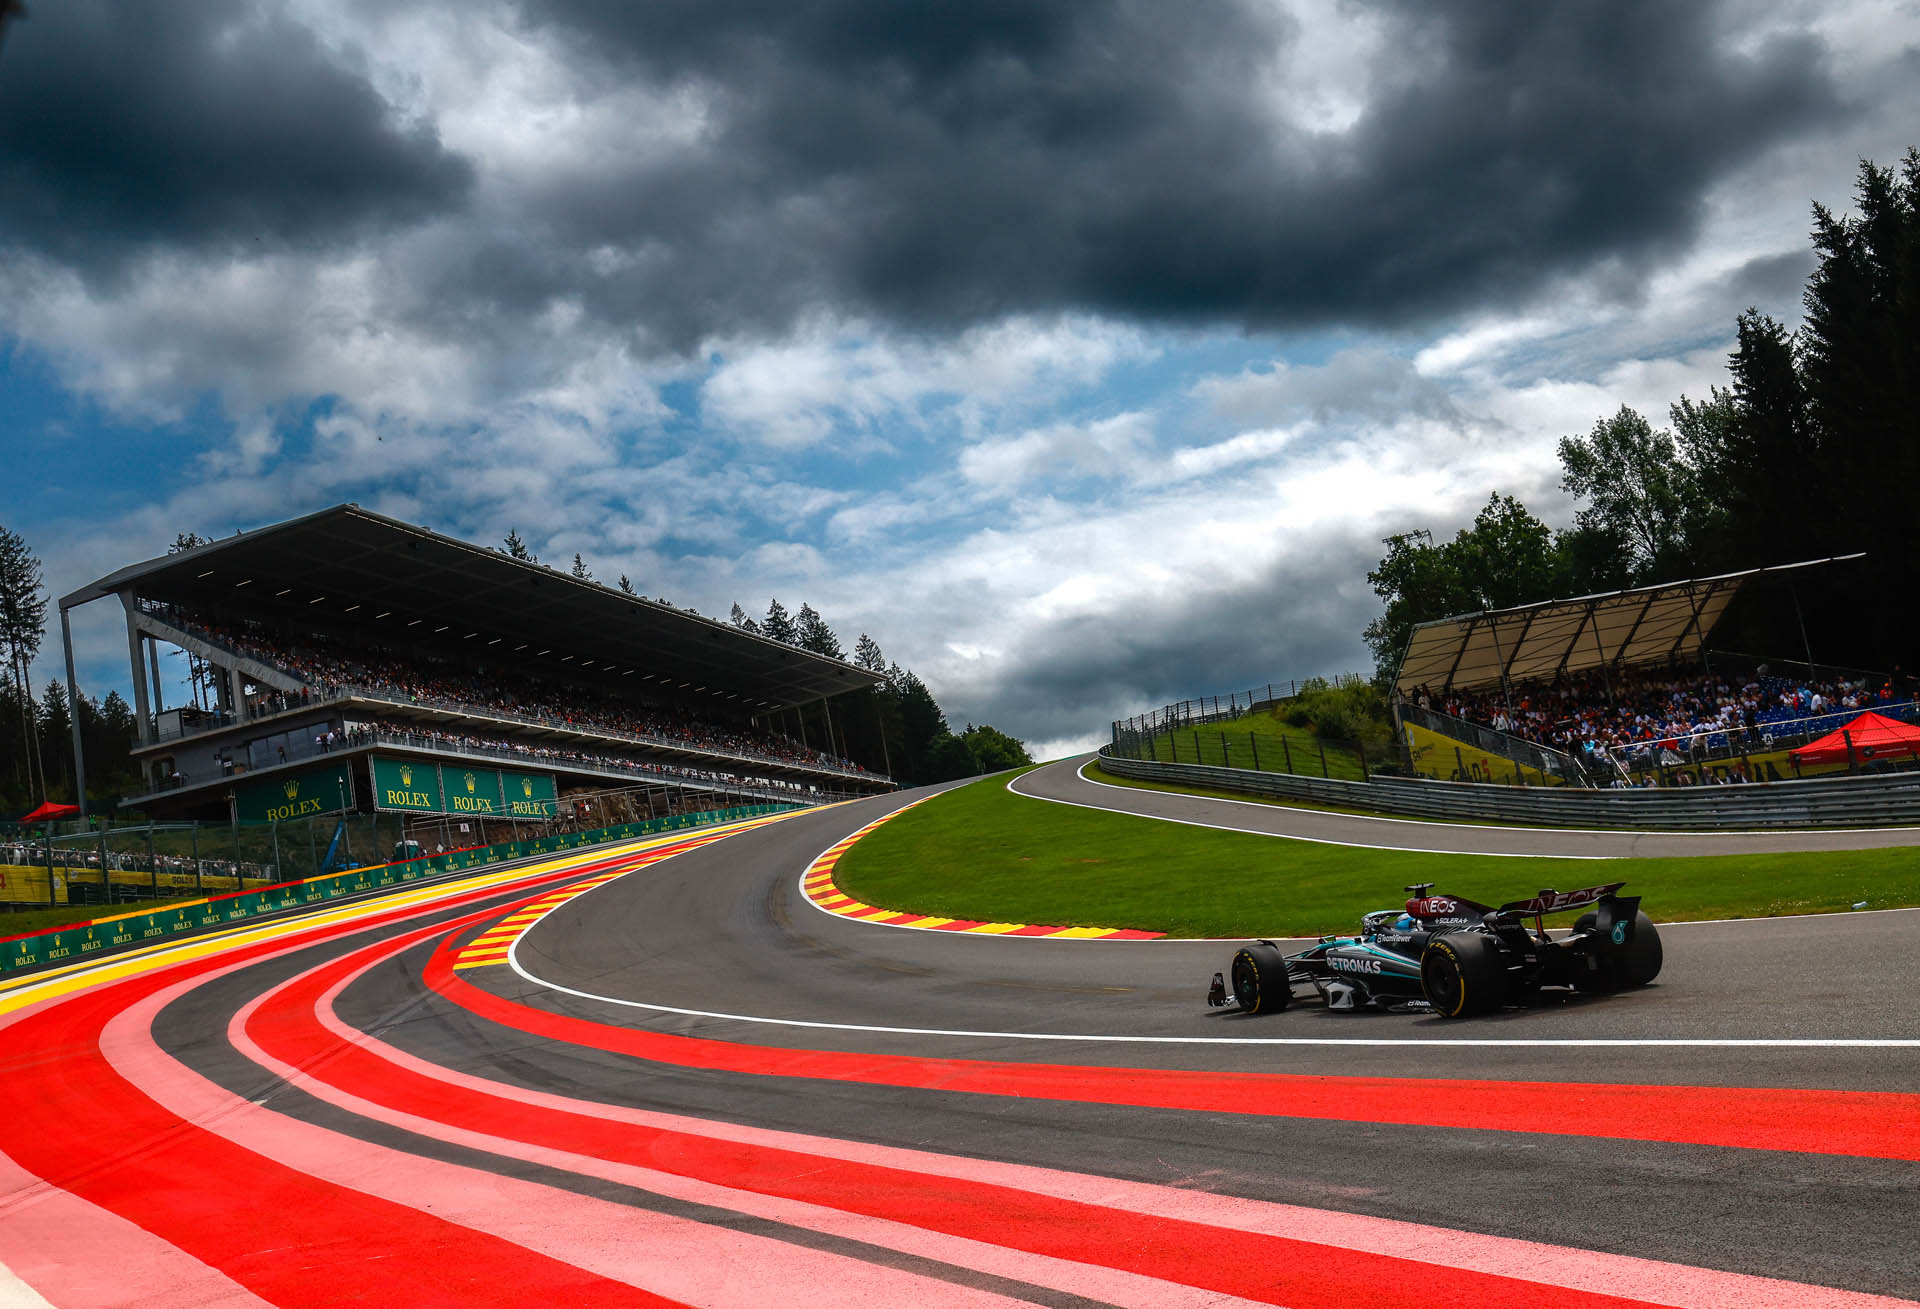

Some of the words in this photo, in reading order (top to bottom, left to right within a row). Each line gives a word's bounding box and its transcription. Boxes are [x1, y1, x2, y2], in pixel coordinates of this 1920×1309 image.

[386, 790, 431, 807] ROLEX
[453, 796, 493, 812] ROLEX
[512, 801, 549, 815] ROLEX
[266, 798, 322, 822] ROLEX
[354, 882, 372, 890] ROLEX
[306, 893, 322, 901] ROLEX
[330, 888, 347, 896] ROLEX
[281, 898, 297, 907] ROLEX
[1528, 886, 1605, 911] INEOS
[257, 903, 273, 912] ROLEX
[1420, 900, 1458, 913] INEOS
[229, 909, 247, 918] ROLEX
[203, 915, 220, 924] ROLEX
[174, 921, 193, 931] ROLEX
[144, 927, 163, 937] ROLEX
[113, 934, 132, 944] ROLEX
[1382, 934, 1412, 943] TeamViewer
[82, 940, 102, 951] ROLEX
[49, 948, 70, 959] ROLEX
[16, 955, 36, 966] ROLEX
[1326, 957, 1381, 975] PETRONAS
